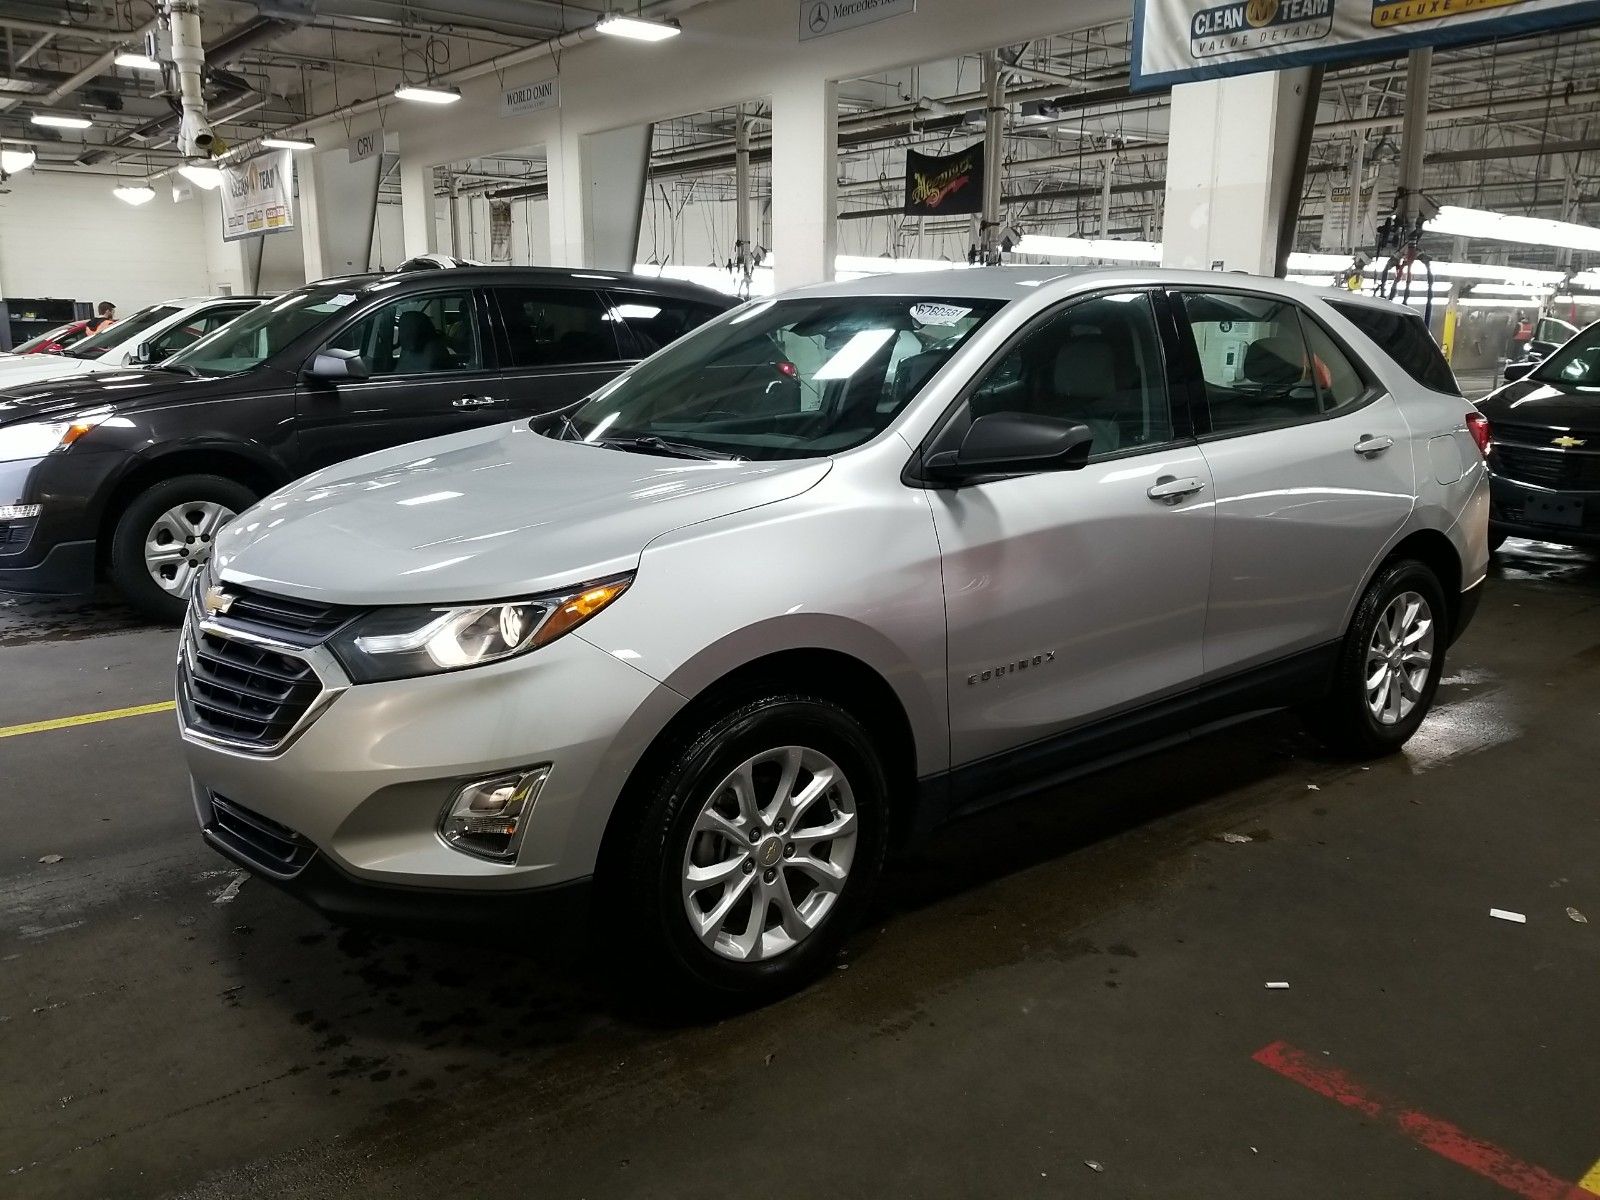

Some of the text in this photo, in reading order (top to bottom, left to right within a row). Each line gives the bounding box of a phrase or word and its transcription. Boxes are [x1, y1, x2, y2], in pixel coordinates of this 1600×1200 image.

[1195, 6, 1244, 35] CLEAN
[1281, 0, 1329, 20] TEAM
[1381, 0, 1451, 22] DELUXE
[1199, 23, 1321, 52] VALUE DETAIL
[506, 82, 552, 106] WORLD OMNI
[357, 133, 374, 156] CRV
[967, 650, 1056, 686] EQUINOX
